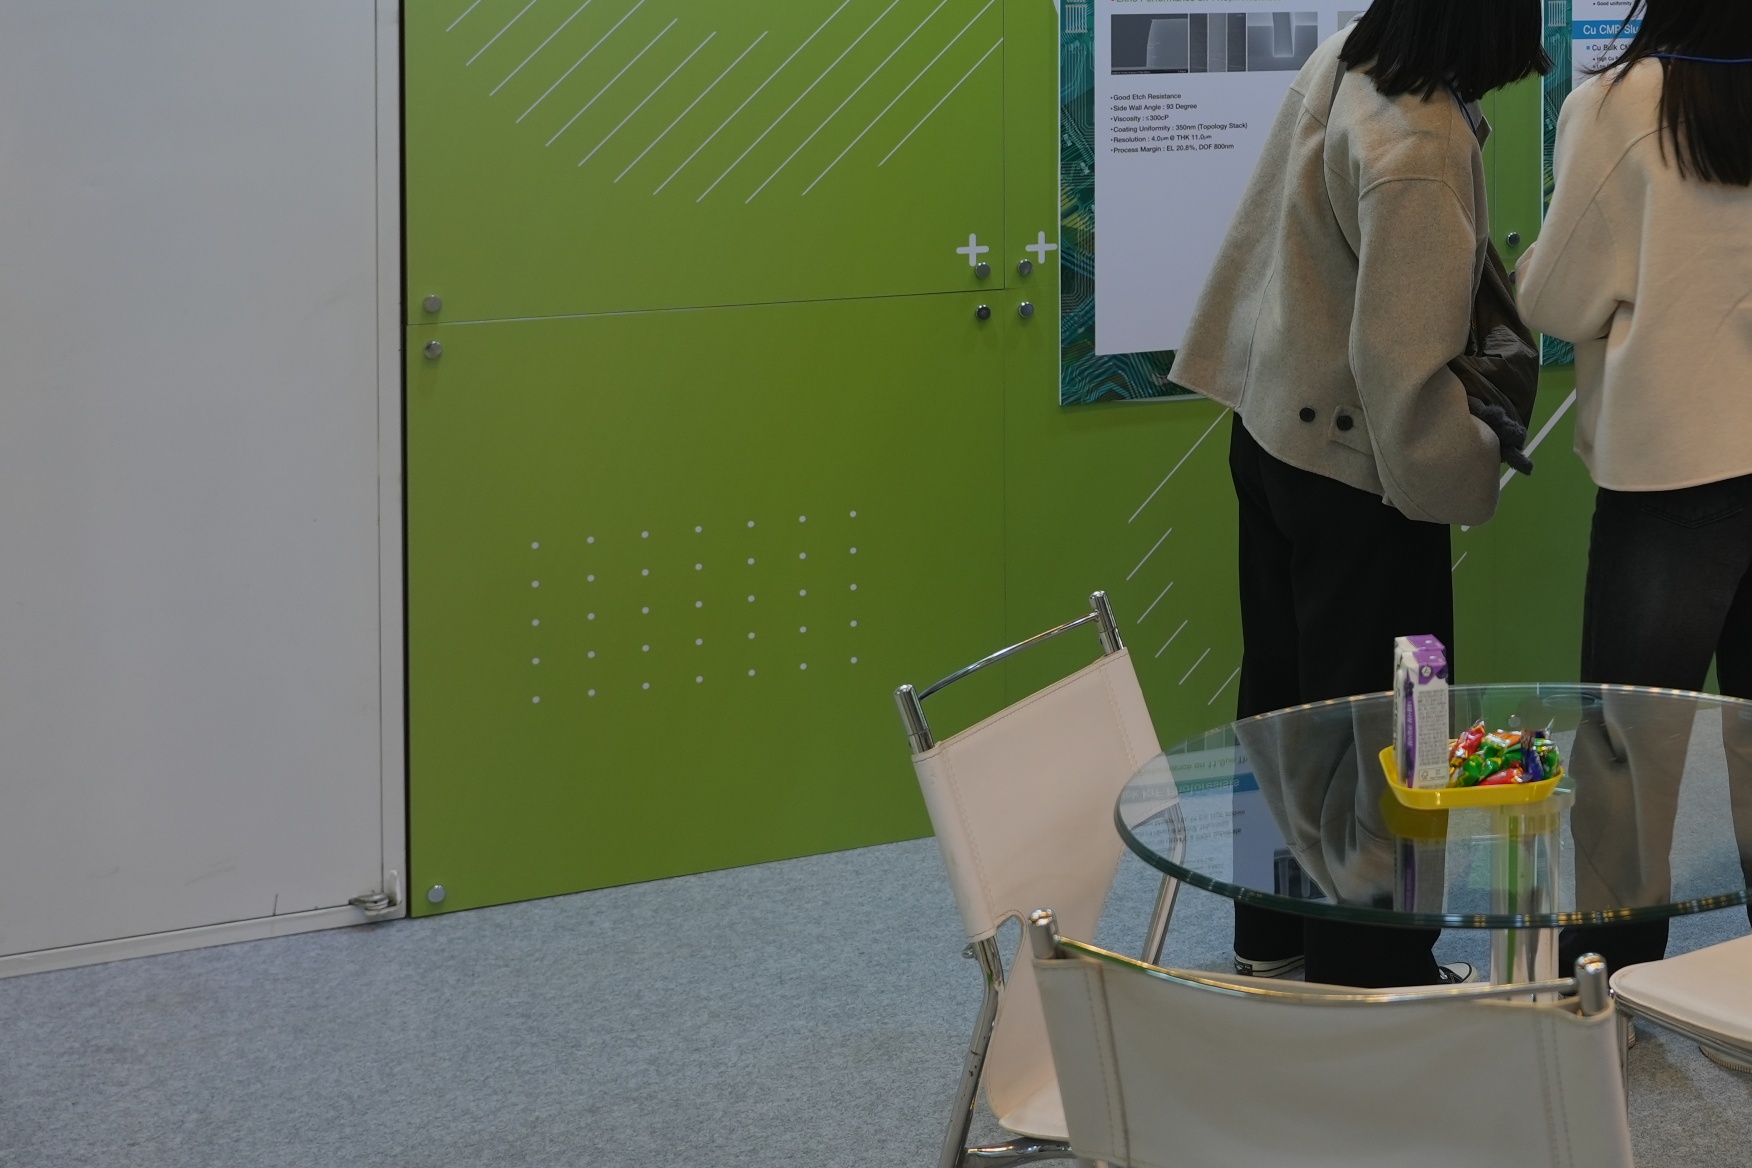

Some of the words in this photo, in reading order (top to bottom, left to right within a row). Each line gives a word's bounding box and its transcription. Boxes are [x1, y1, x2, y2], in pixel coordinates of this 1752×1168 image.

[1583, 25, 1596, 35] Cu
[1143, 104, 1162, 112] Angle
[1176, 103, 1197, 111] Degree
[1113, 115, 1141, 123] Viscosity
[1113, 126, 1137, 134] Coating
[1139, 124, 1170, 133] Uniformity
[1198, 123, 1227, 132] (Topology
[1140, 146, 1161, 154] Margin
